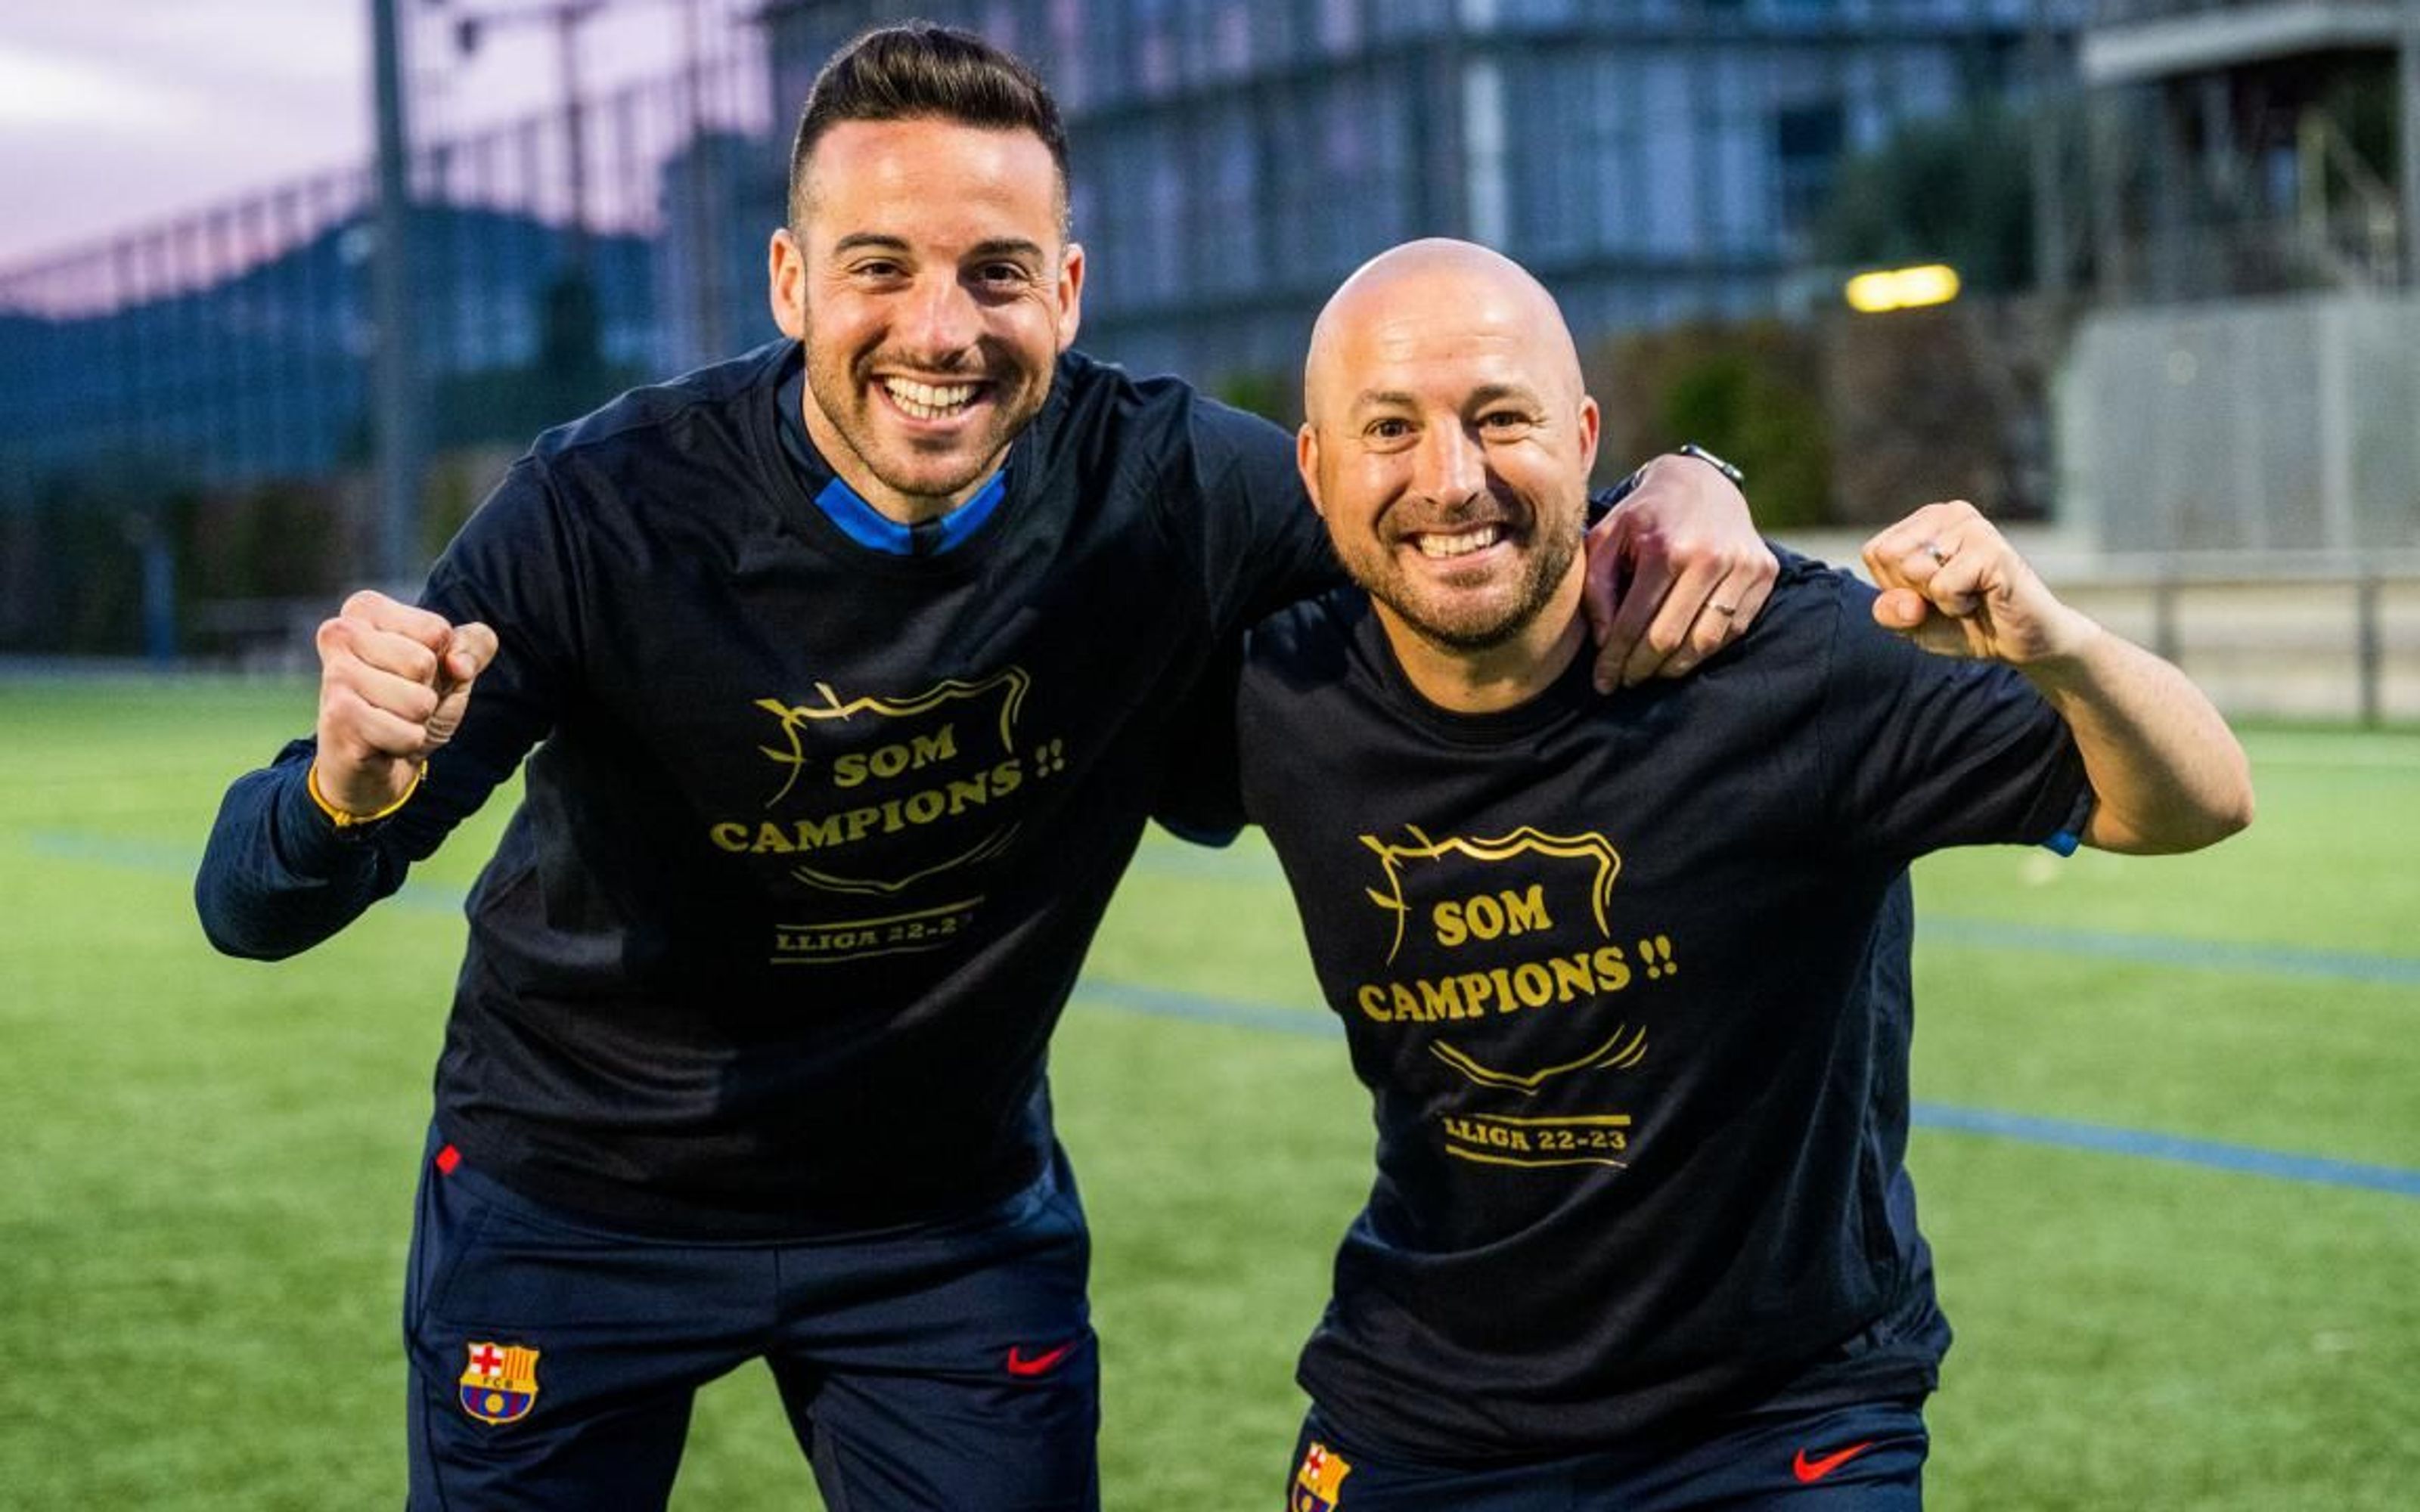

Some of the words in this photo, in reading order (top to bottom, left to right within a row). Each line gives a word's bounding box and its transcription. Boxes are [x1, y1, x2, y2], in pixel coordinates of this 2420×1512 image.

[833, 722, 958, 787] SOM
[709, 758, 1022, 854] CAMPIONS
[776, 931, 879, 951] LLIGA
[888, 912, 974, 943] 22-2
[1432, 884, 1553, 947] SOM
[1357, 946, 1631, 1022] CAMPIONS
[1443, 1117, 1531, 1151] LLIGA
[1537, 1129, 1627, 1151] 22-23
